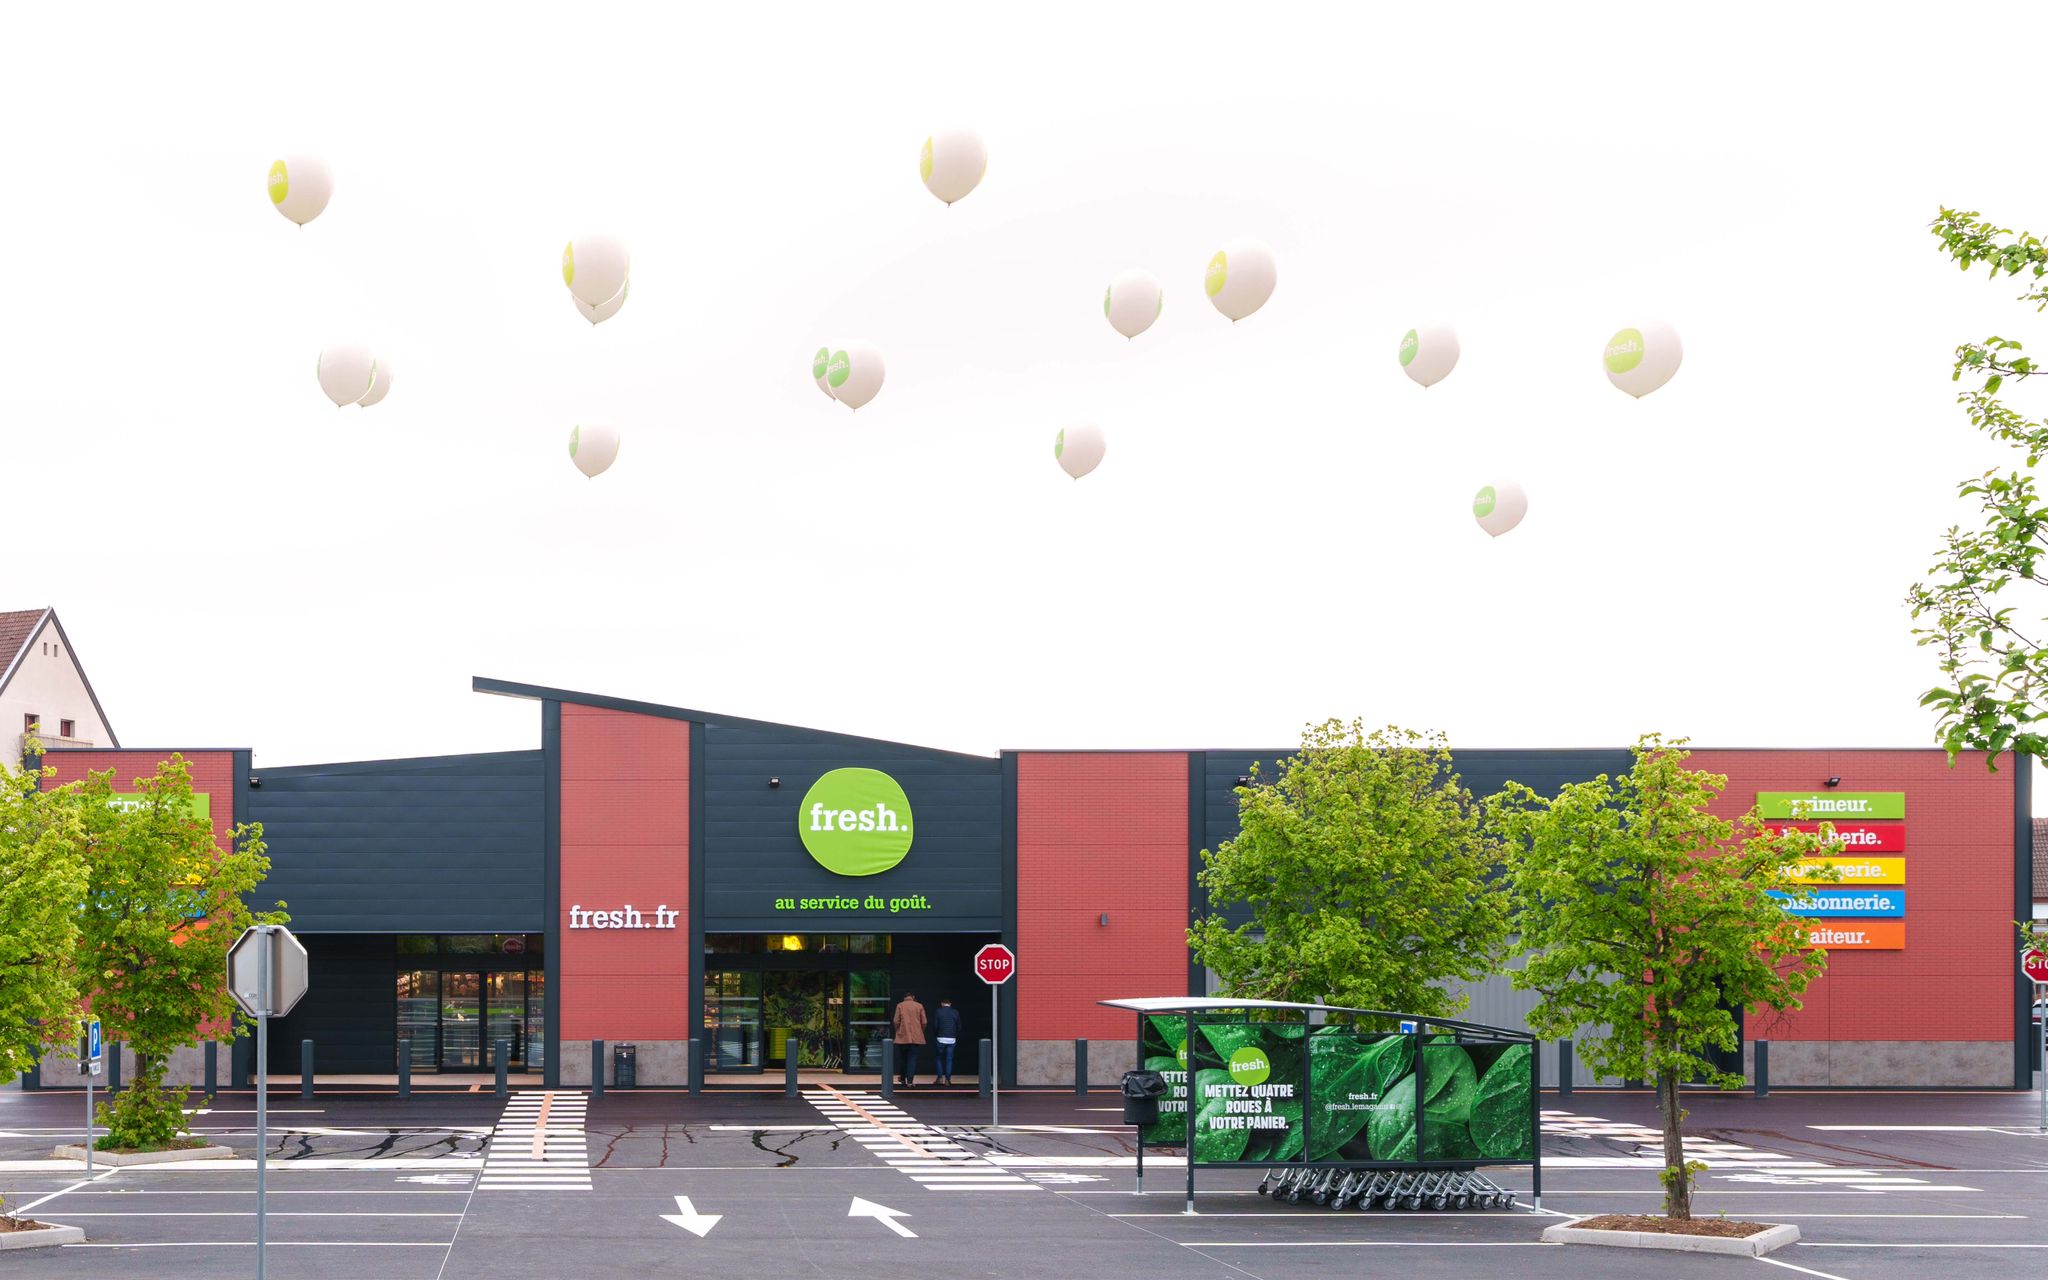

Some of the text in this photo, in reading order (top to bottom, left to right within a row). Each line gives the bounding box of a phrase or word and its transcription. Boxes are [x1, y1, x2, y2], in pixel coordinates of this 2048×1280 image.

[810, 803, 908, 832] fresh.
[775, 895, 931, 912] au service du goût.
[1777, 894, 1896, 910] oissonnerie.
[569, 904, 679, 929] fresh.fr
[1794, 929, 1870, 944] aiteur.
[980, 959, 1010, 970] STOP
[93, 1028, 98, 1051] P
[1232, 1059, 1268, 1073] fresh.
[1205, 1084, 1294, 1098] METTEZ QUATRE
[1348, 1092, 1378, 1100] fresh.fr
[1226, 1097, 1272, 1113] ROUES À
[1209, 1116, 1290, 1129] VOTRE PANIER.
